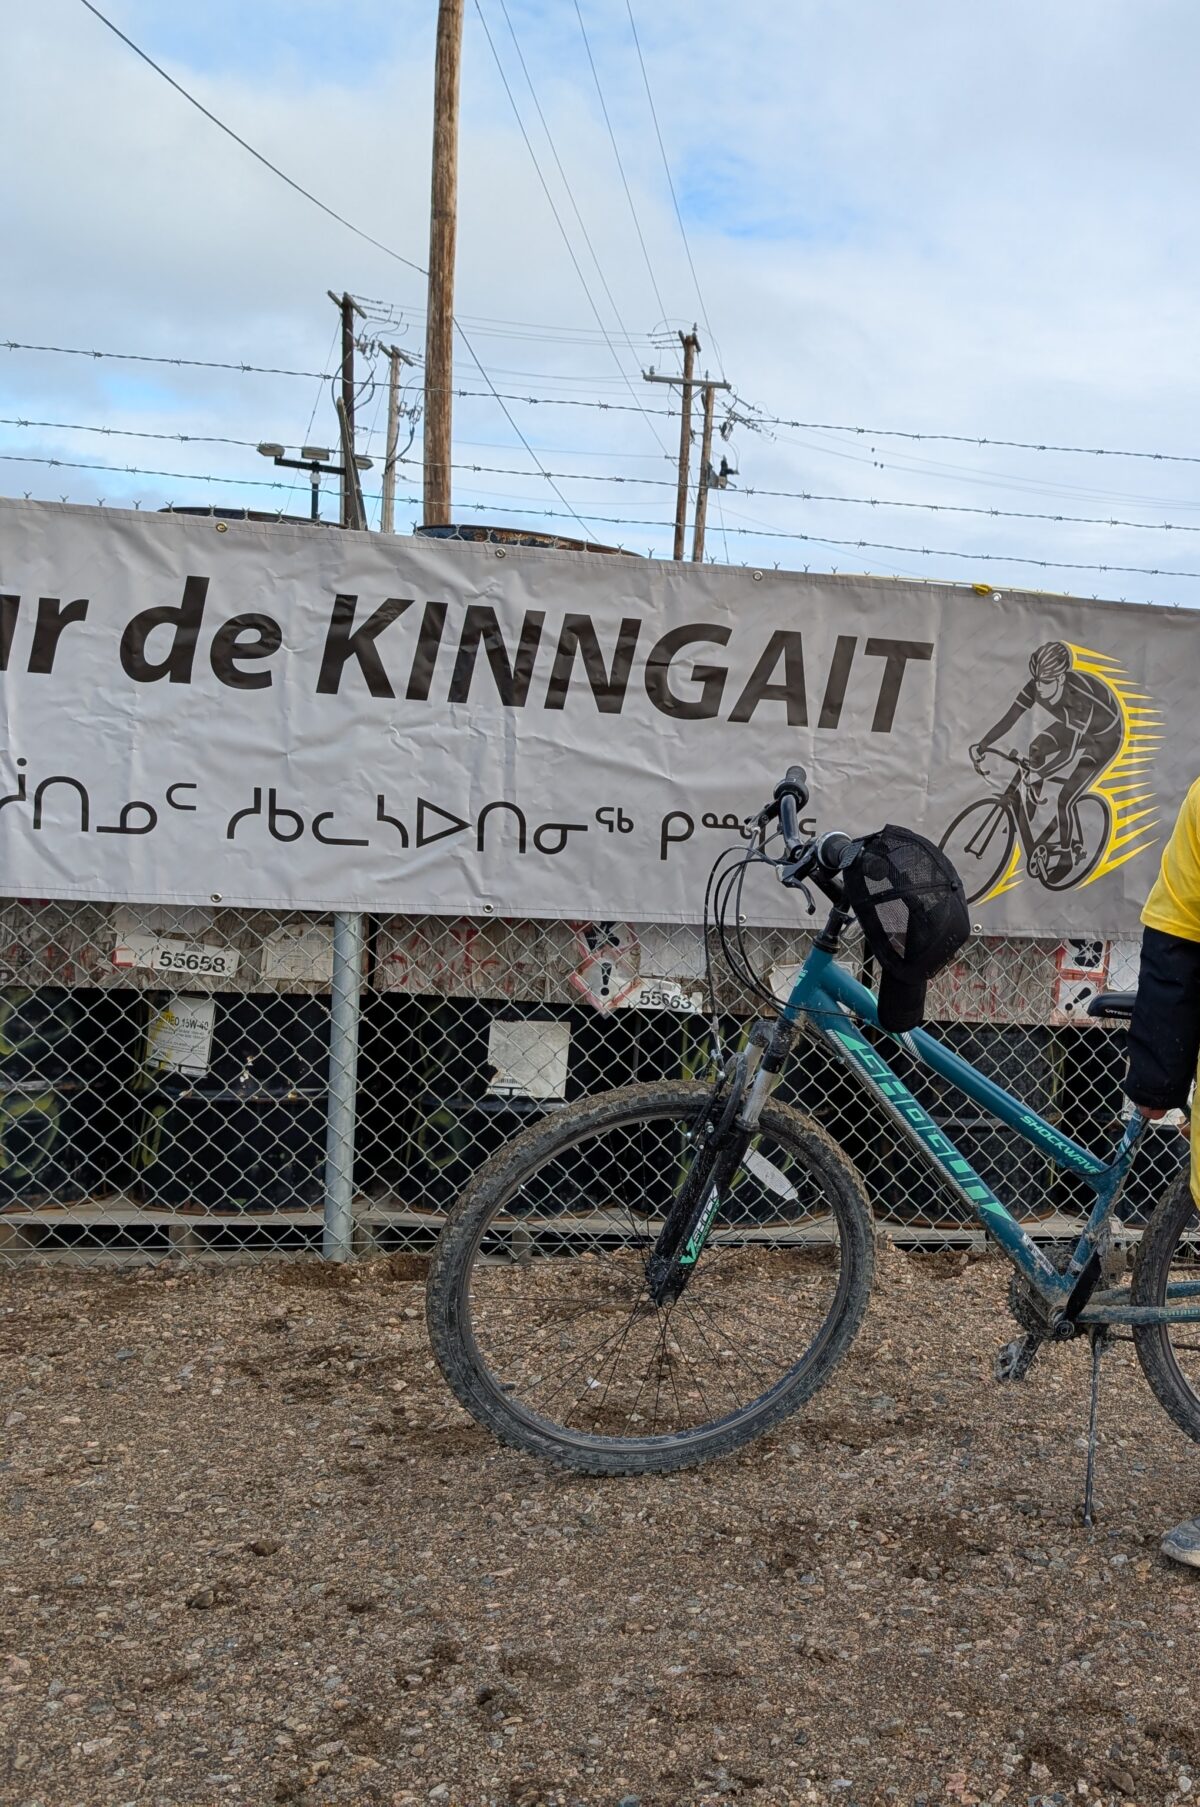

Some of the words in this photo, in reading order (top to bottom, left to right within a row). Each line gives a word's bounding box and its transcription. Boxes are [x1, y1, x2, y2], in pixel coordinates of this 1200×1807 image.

[119, 575, 284, 691] de
[315, 593, 935, 734] KINNGAIT
[158, 951, 226, 973] 55658
[639, 990, 692, 1009] 55663
[1019, 1114, 1101, 1175] SHOCKWAVE
